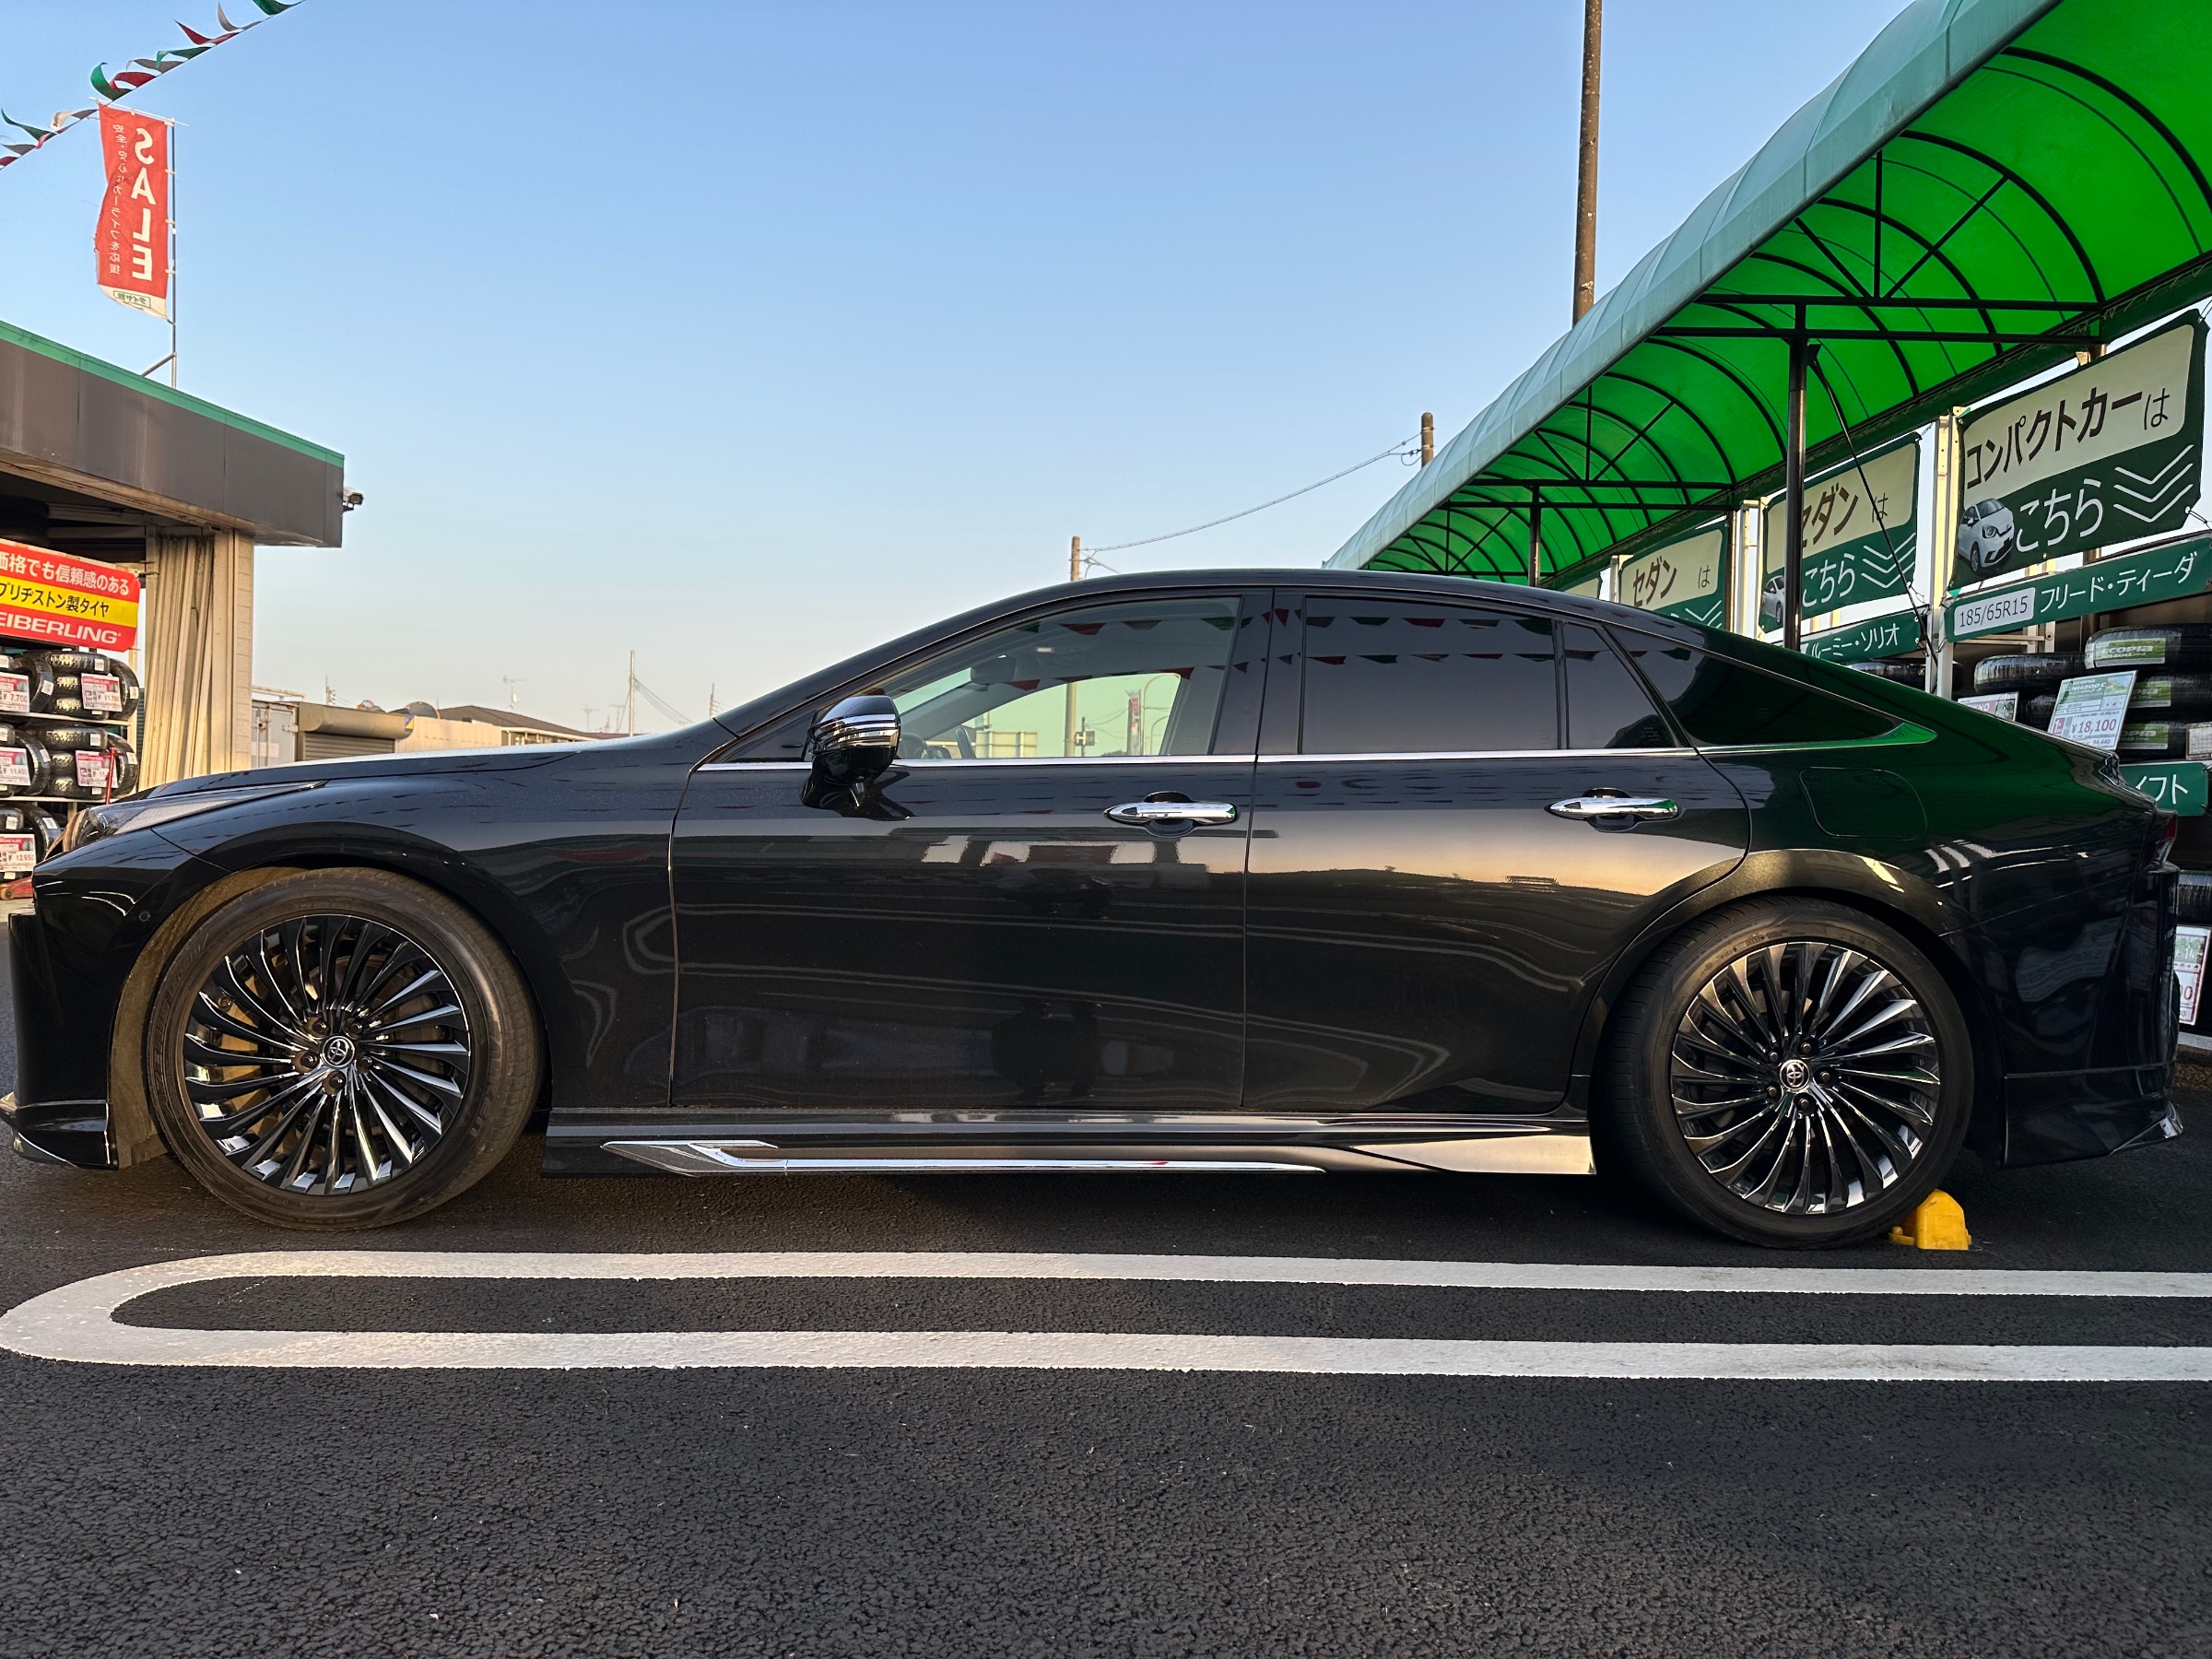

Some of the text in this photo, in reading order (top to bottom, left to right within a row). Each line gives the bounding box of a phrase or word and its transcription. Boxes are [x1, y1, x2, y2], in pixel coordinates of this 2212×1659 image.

[1967, 387, 2171, 489] コンパクトカーは
[2016, 478, 2103, 553] こちら
[1802, 553, 1855, 608] こちら
[1959, 595, 2028, 627] 185/65R15
[2040, 551, 2198, 613] フリード・ティーダ
